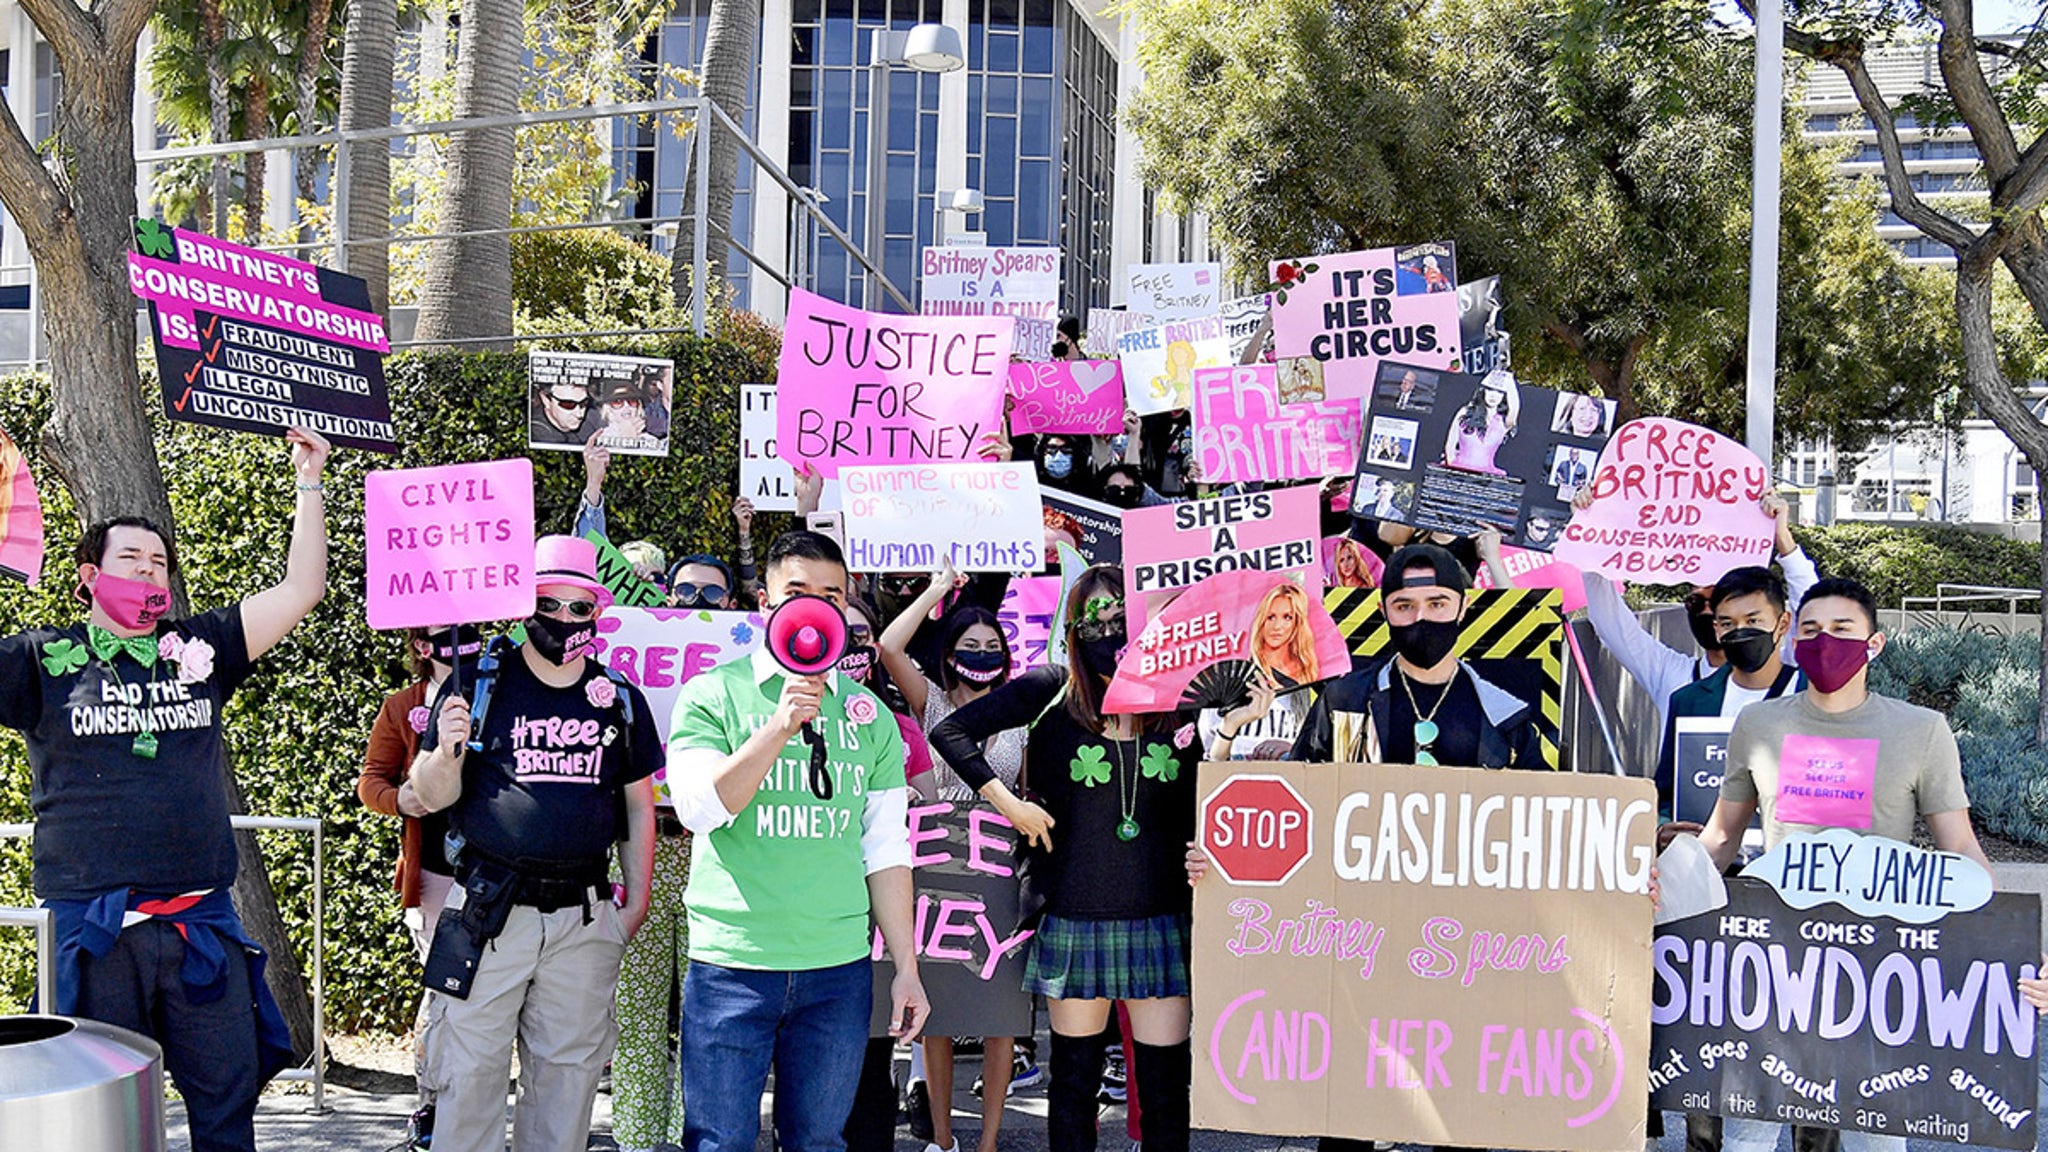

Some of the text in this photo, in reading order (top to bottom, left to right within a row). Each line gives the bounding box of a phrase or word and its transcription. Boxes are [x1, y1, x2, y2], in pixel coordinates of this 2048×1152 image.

[178, 237, 320, 295] BRITNEY'S
[924, 249, 1055, 281] Britney Spears
[1131, 273, 1174, 294] FREE
[1332, 269, 1395, 298] IT'S
[128, 261, 386, 345] CONSERVATORSHIP
[962, 280, 1004, 297] IS A
[1153, 292, 1212, 311] BRITNEY
[158, 311, 199, 342] IS:
[1165, 314, 1223, 346] BRITNEY
[1323, 298, 1393, 330] HER
[223, 322, 353, 368] FRAUDULENT
[803, 315, 997, 377] JUSTICE
[203, 368, 292, 401] ILLEGAL
[227, 349, 369, 394] MISOGYNISTIC
[194, 391, 394, 440] UNCONSTITUTIONAL
[850, 381, 936, 422] FOR
[1022, 400, 1117, 431] Britney
[797, 408, 980, 460] BRITNEY
[1198, 415, 1359, 481] BRITNEY
[1616, 421, 1716, 469] FREE
[401, 478, 495, 508] CIVIL
[757, 476, 797, 497] AL
[1175, 494, 1272, 531] SHE'S
[1638, 504, 1701, 529] END
[387, 518, 511, 551] RIGHTS
[850, 537, 1037, 569] Human rights
[1213, 527, 1236, 552] A
[1566, 523, 1772, 556] CONSERVATORSHIP
[388, 563, 521, 597] MATTER
[596, 546, 668, 607] WHE
[1135, 540, 1314, 592] PRISONER!
[1602, 551, 1701, 574] ABUSE
[1138, 610, 1220, 652] #FREE
[1139, 631, 1245, 676] BRITNEY
[148, 680, 191, 702] THE
[71, 700, 213, 737] CONSERVATORSHIP
[837, 719, 860, 751] IS
[513, 745, 603, 784] BRITNEY!
[1783, 785, 1865, 800] FREE BRITNEY
[756, 803, 851, 840] MONEY?
[1212, 803, 1303, 851] STOP
[1333, 792, 1652, 895] GASLIGHTING
[1780, 842, 1961, 908] HEY, JAMIE
[1226, 897, 1571, 988] Britney Spears
[1719, 916, 1941, 950] HERE COMES THE
[1651, 935, 2038, 1060] SHOWDOWN
[1210, 989, 1626, 1129] (AND HER FANS)
[1648, 1040, 2032, 1131] hat goes around comes around
[1682, 1090, 1970, 1142] and the crowds are waiting
